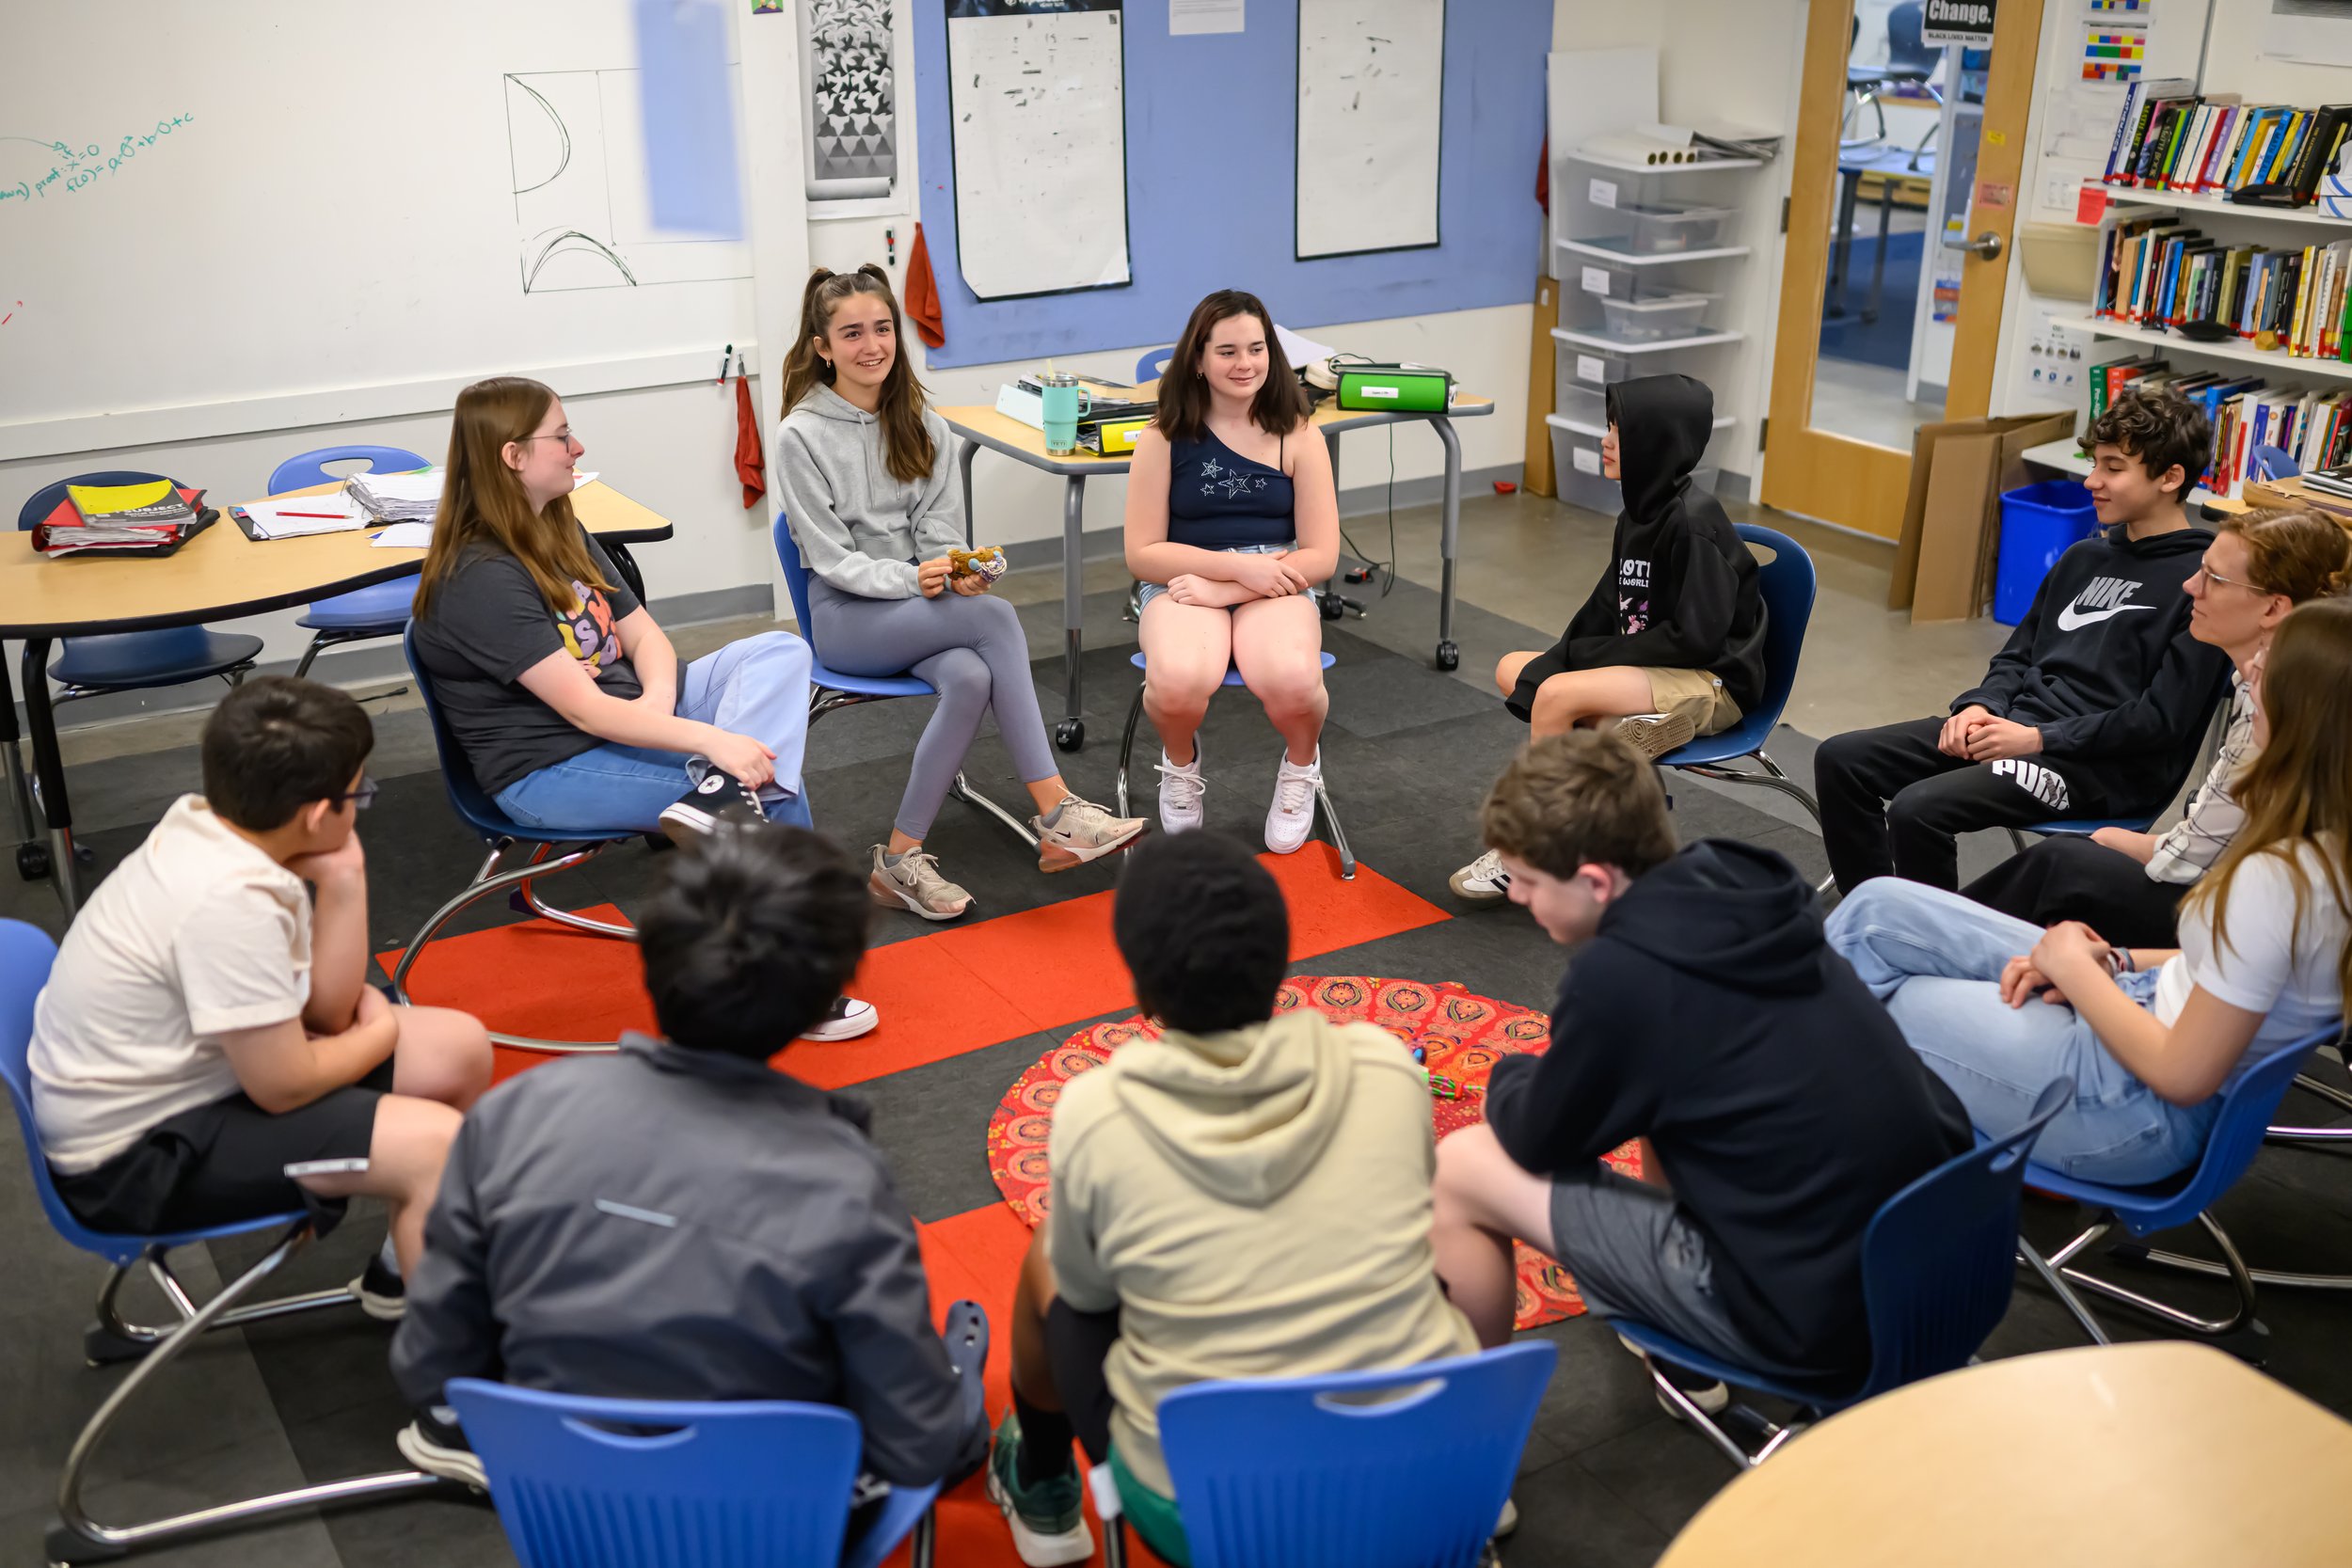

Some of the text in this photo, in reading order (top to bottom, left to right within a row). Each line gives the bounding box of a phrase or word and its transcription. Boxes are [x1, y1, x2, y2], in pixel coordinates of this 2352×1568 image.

[1929, 0, 1992, 25] Change.
[1928, 31, 1947, 40] BLACK
[1964, 34, 1988, 42] MATTER
[2075, 577, 2143, 610] NIKE
